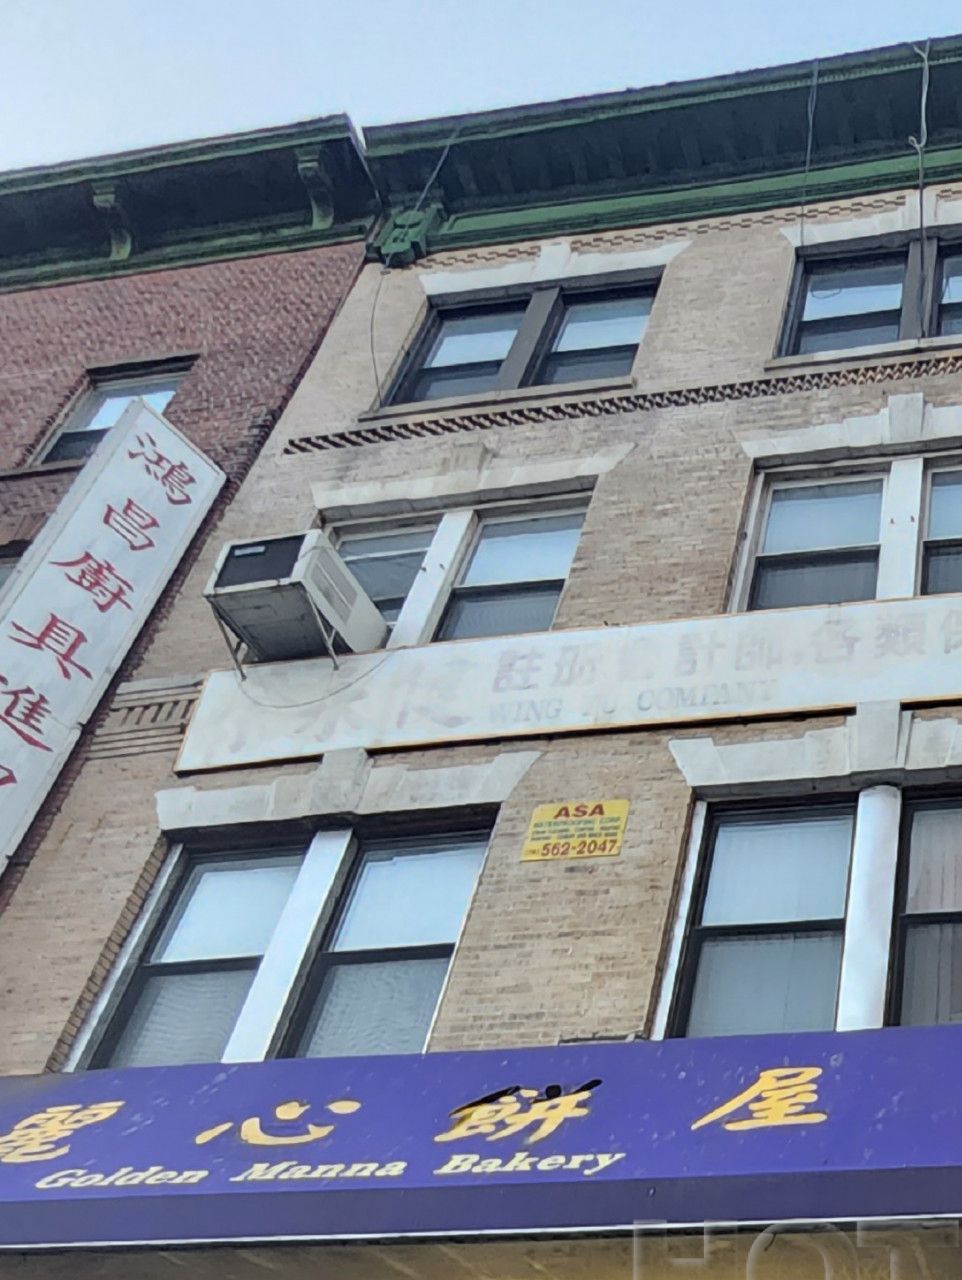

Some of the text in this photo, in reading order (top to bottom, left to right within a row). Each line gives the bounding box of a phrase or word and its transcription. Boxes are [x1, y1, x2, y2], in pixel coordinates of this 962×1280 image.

[552, 803, 605, 819] ASA
[541, 839, 618, 857] 562-2047
[35, 1151, 627, 1189] Golden Manna Bakery
